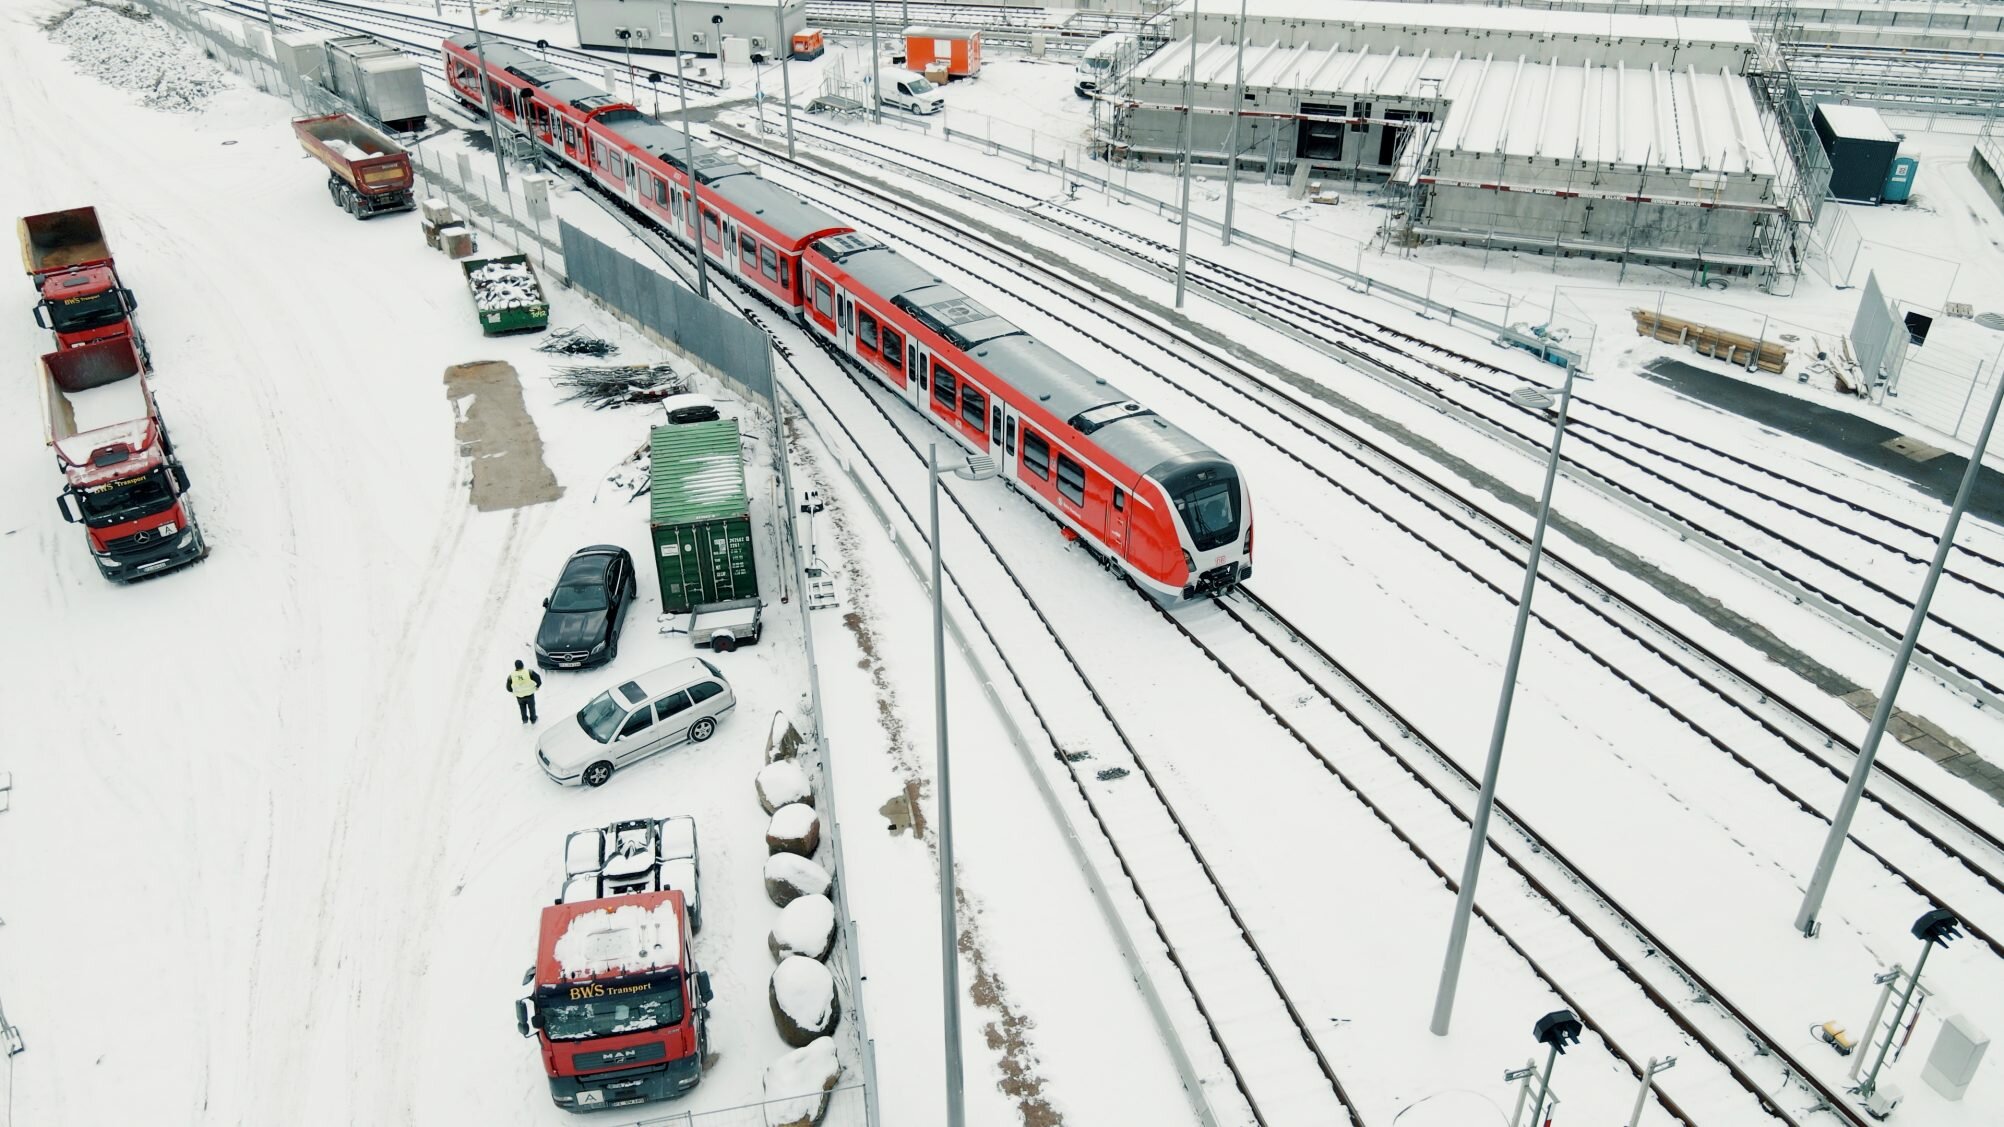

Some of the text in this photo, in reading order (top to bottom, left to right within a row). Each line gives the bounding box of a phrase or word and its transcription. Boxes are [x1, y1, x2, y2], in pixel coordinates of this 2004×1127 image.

[165, 526, 173, 534] A
[570, 982, 651, 1000] BWS Transport
[602, 1050, 636, 1060] MAN
[585, 1093, 597, 1103] A
